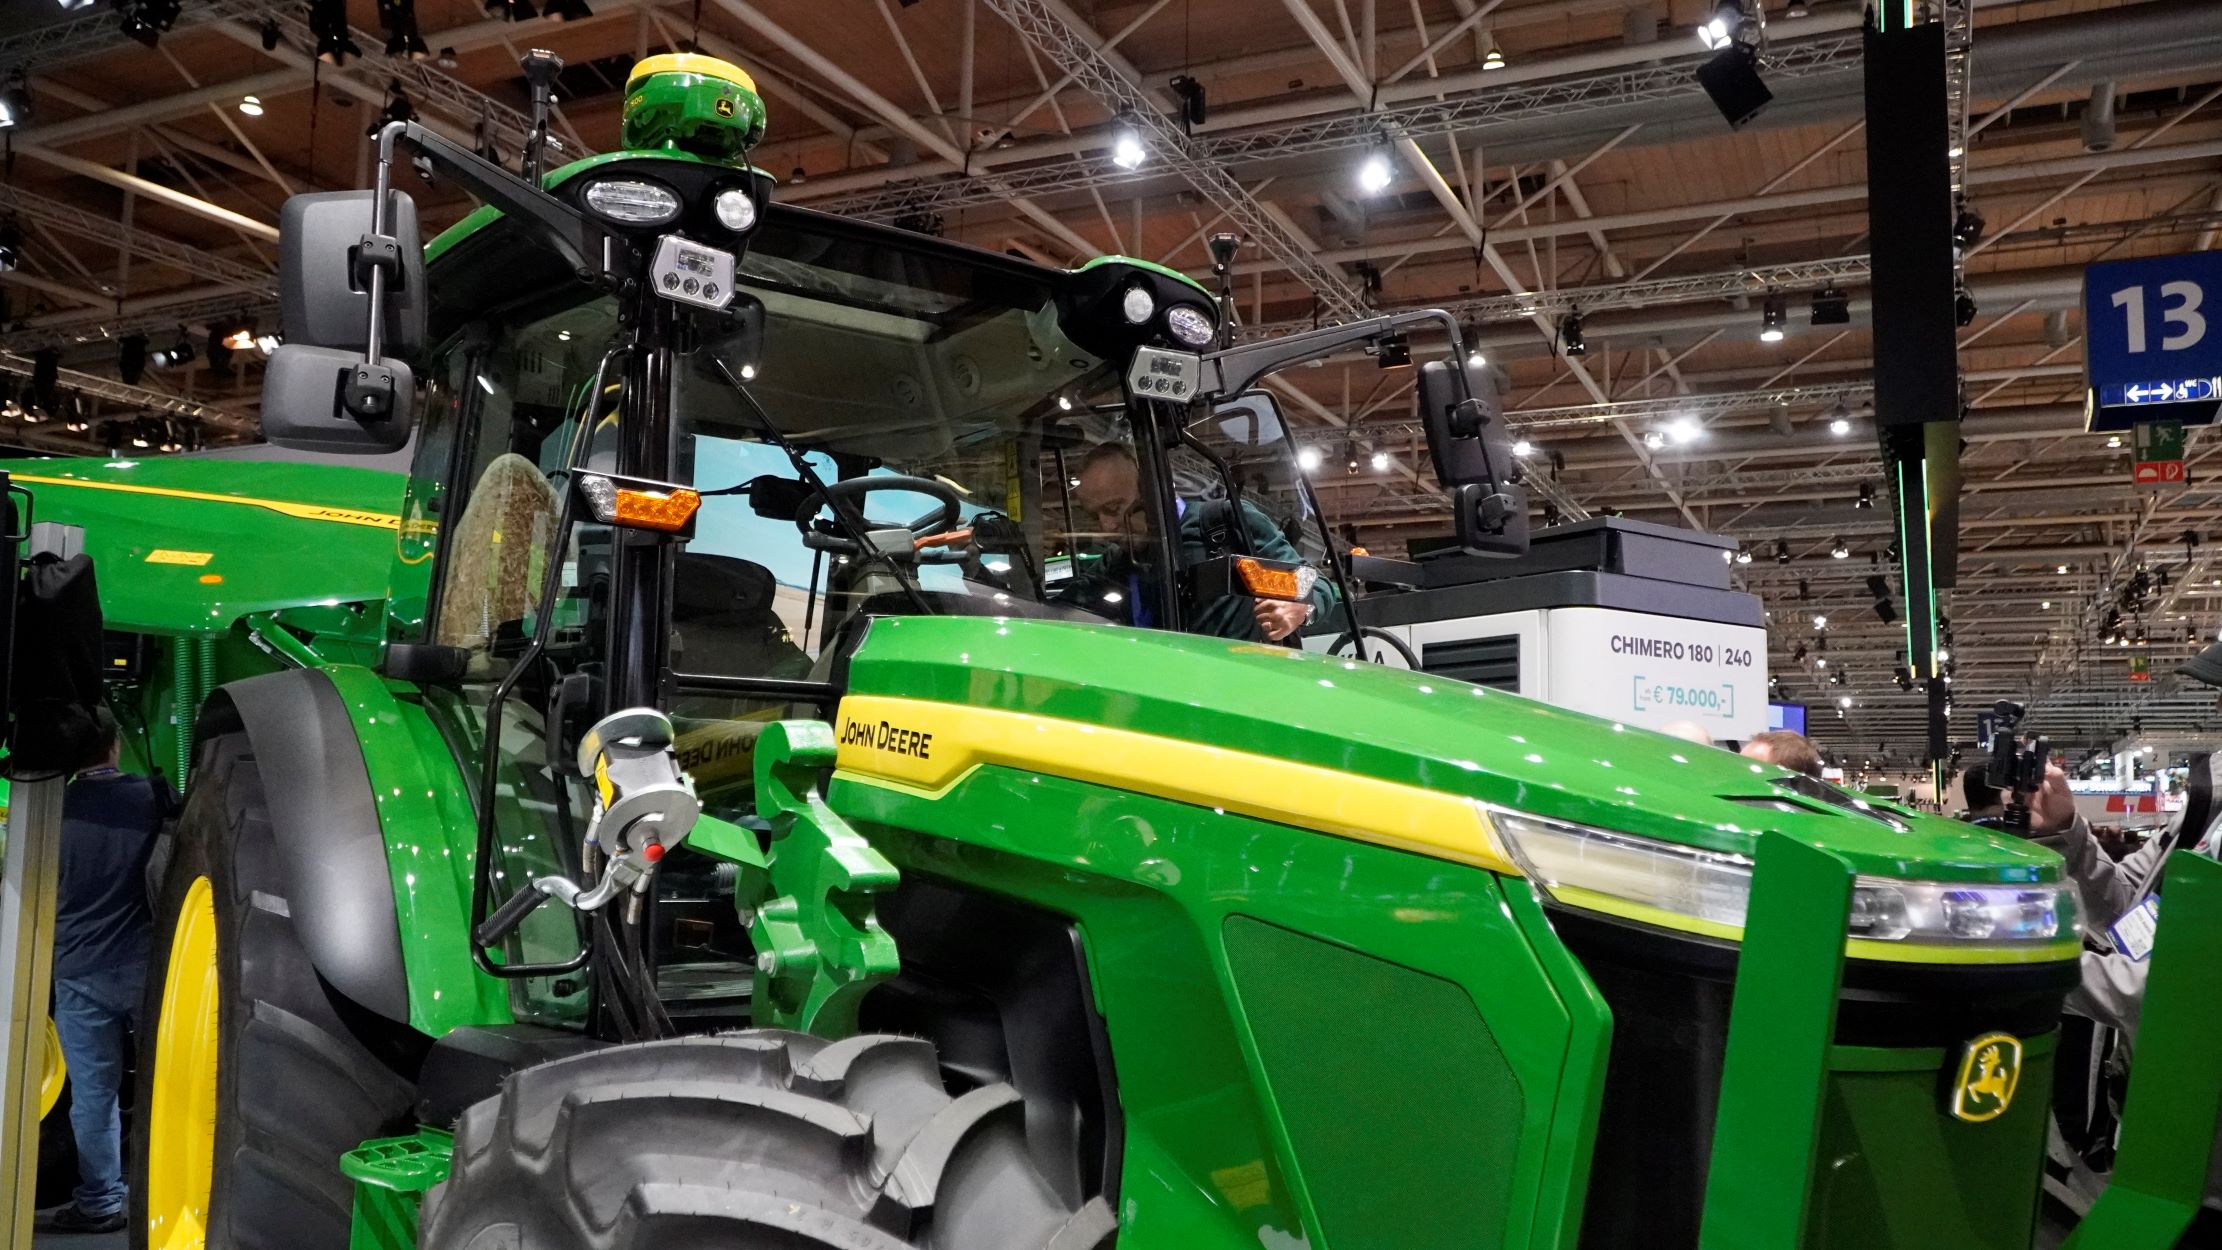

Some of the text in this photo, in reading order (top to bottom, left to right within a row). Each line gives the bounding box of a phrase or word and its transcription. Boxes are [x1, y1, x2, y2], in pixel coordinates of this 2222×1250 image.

[2111, 280, 2207, 353] 13
[308, 510, 382, 523] JOHN
[1611, 634, 1752, 668] CHIMERO 180 240
[840, 716, 933, 760] JOHN DEERE
